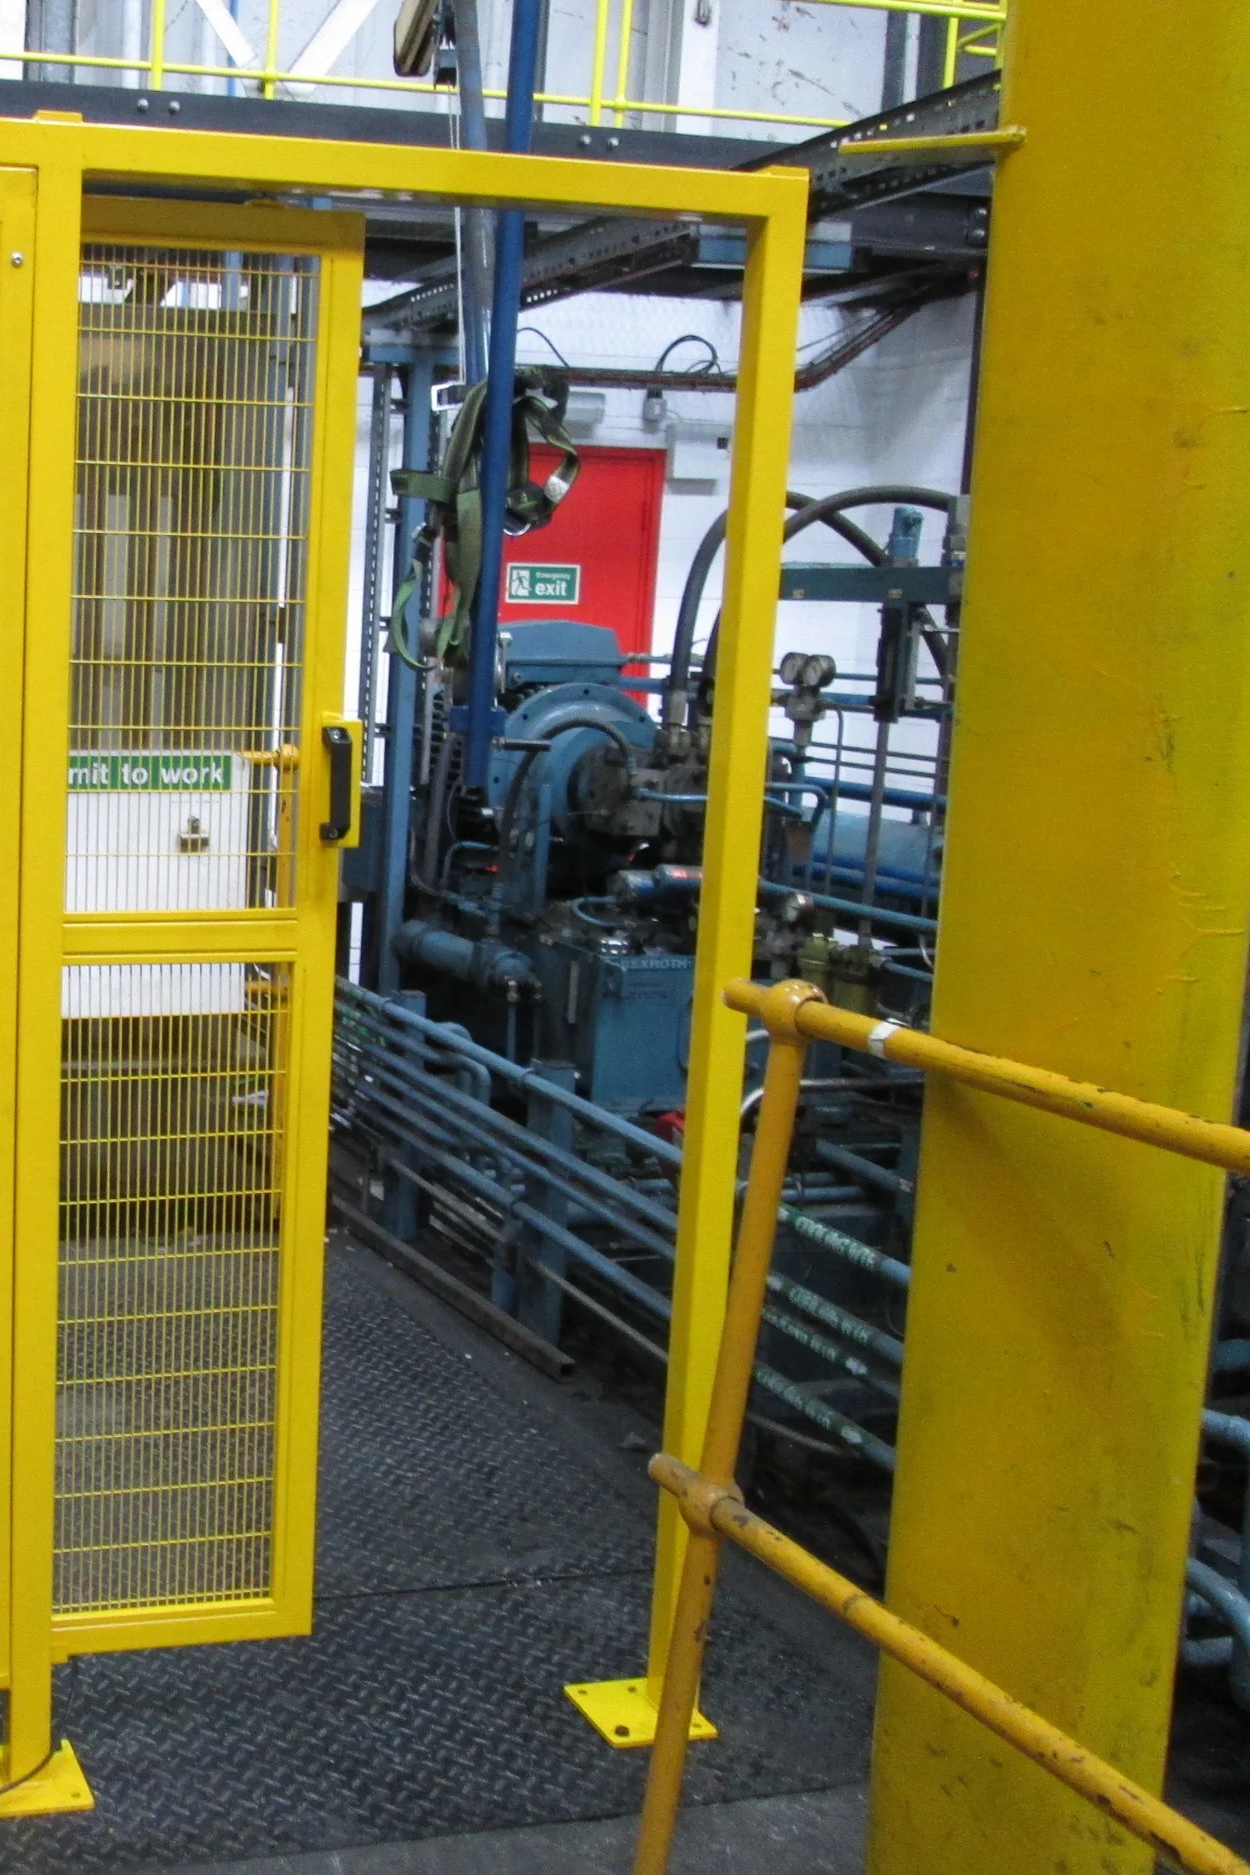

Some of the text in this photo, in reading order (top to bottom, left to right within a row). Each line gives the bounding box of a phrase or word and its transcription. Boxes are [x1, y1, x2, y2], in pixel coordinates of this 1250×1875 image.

[535, 580, 567, 596] exit
[122, 763, 148, 785] to
[161, 762, 224, 785] work
